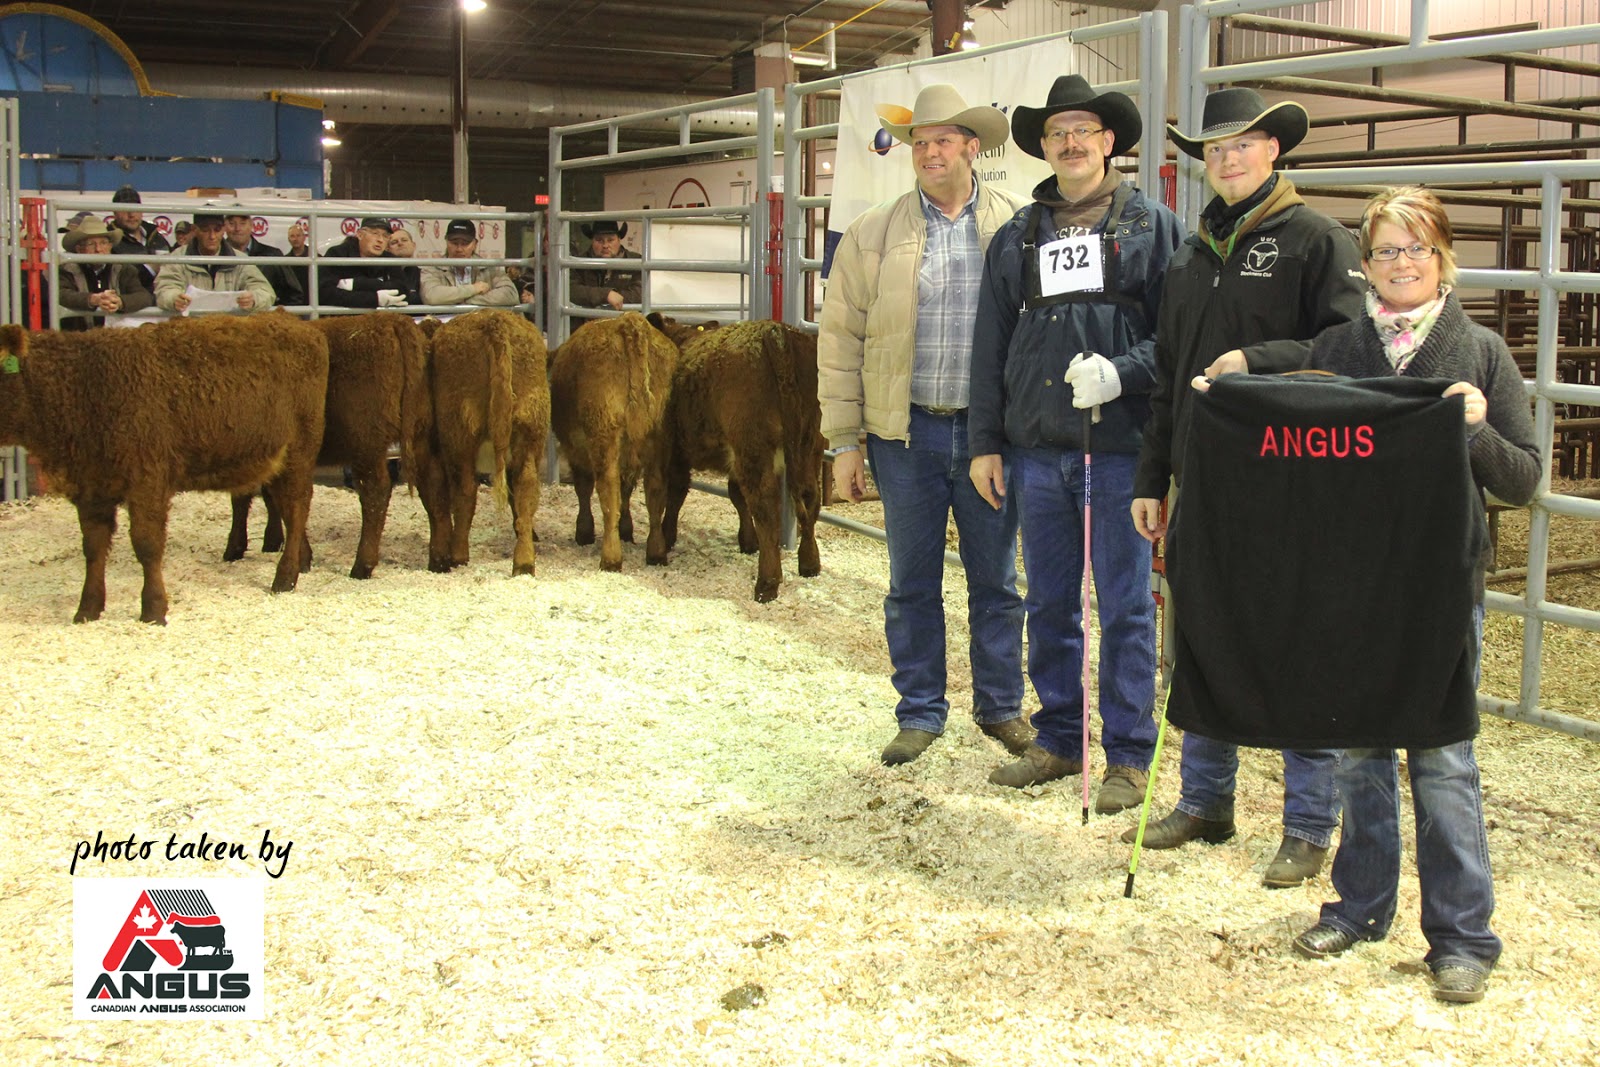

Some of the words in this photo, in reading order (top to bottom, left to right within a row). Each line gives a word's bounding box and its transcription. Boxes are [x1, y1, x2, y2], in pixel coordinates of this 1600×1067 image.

[979, 168, 1007, 182] lution
[1048, 244, 1090, 274] 732
[1260, 425, 1374, 458] ANGUS
